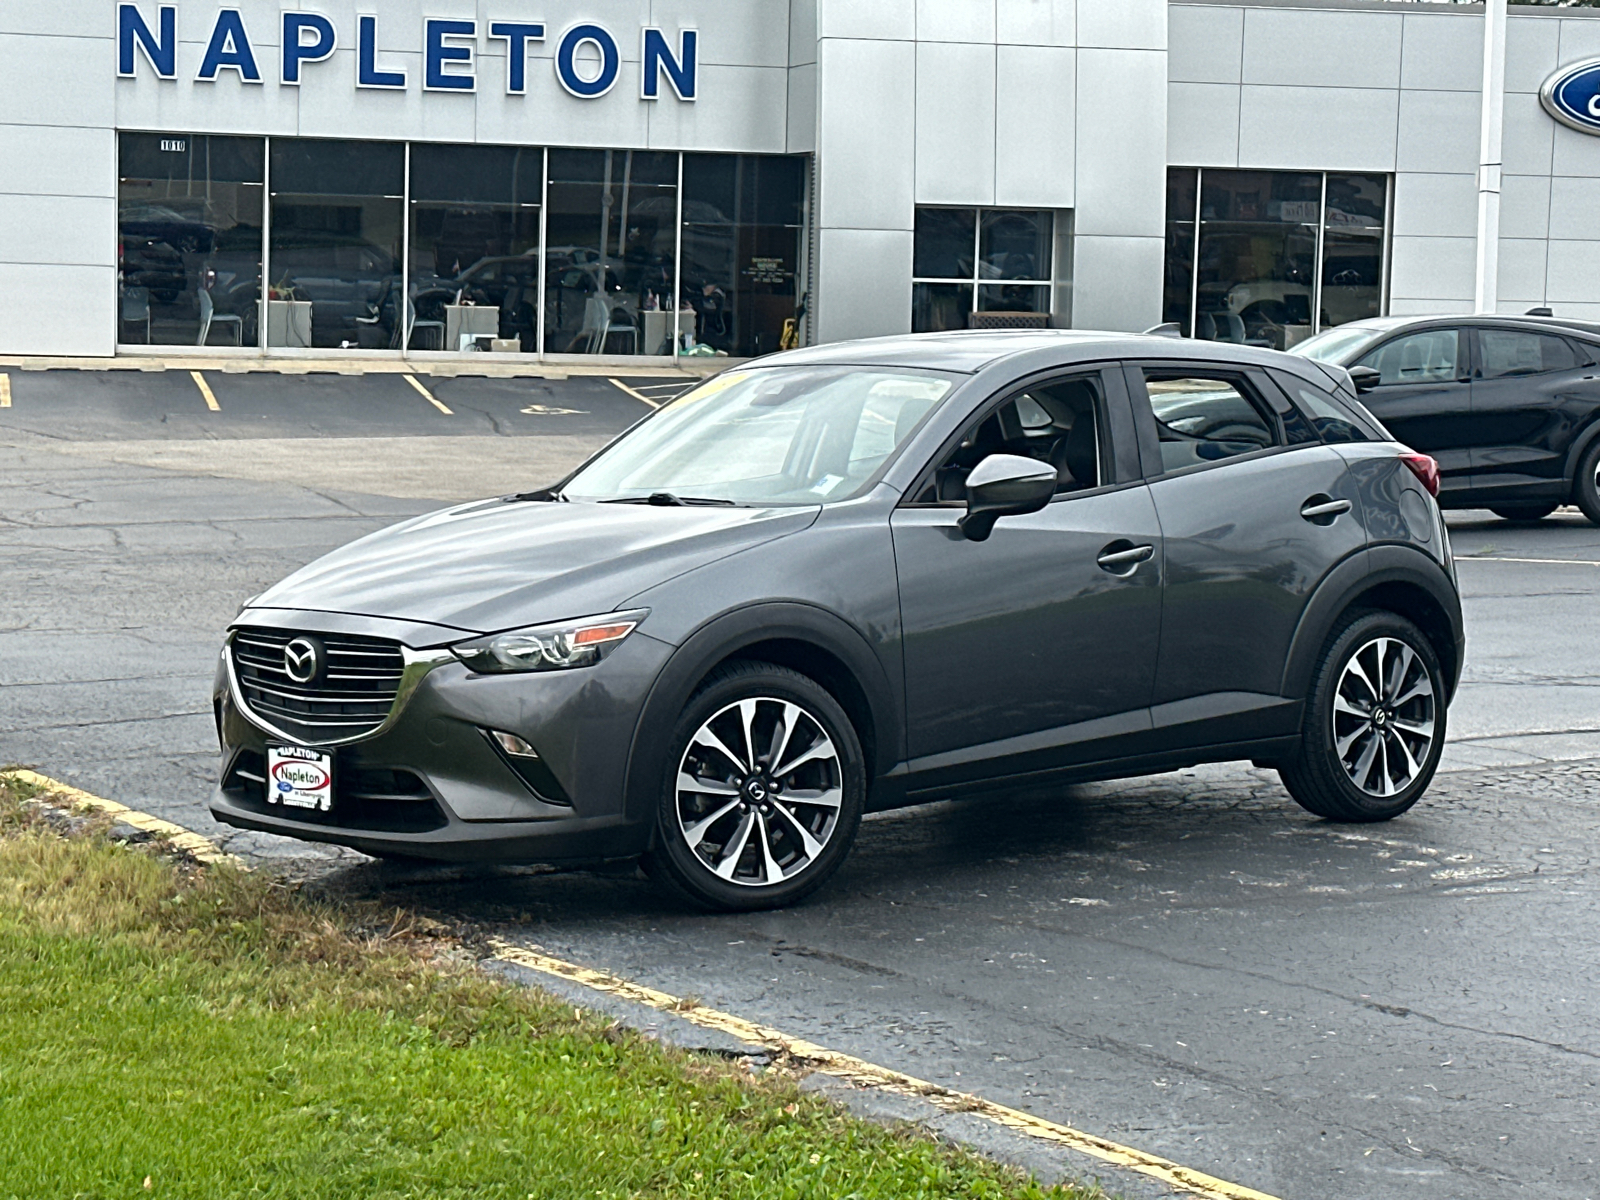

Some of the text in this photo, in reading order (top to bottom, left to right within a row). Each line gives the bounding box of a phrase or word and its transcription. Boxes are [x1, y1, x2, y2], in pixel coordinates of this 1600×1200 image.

[116, 3, 697, 101] NAPLETON
[161, 140, 185, 151] 1010
[281, 766, 320, 784] Napleton
